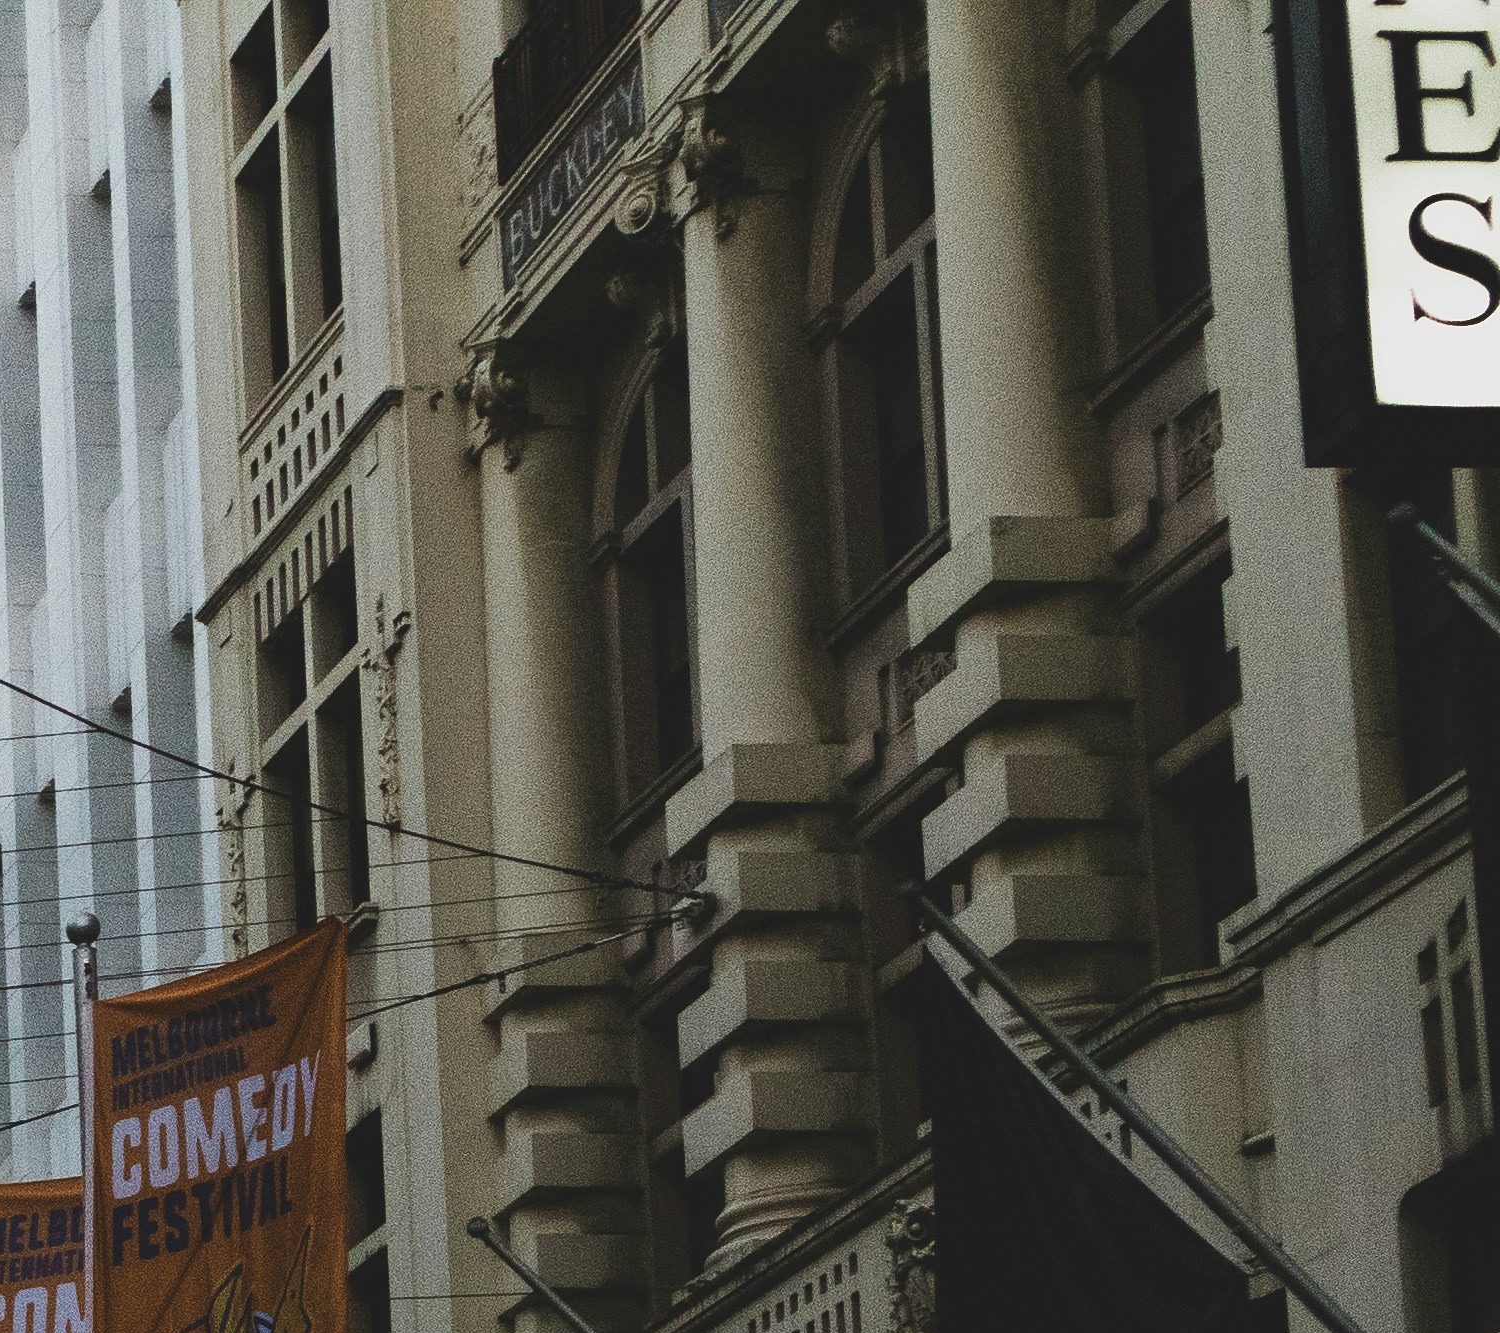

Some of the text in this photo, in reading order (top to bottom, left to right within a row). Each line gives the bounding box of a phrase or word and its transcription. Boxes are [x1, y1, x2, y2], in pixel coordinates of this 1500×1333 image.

[508, 65, 638, 265] BUCKLEY
[111, 984, 276, 1078] MELBOURNE
[112, 1045, 248, 1110] INTERNATIONAL
[110, 1049, 321, 1200] COMEDY
[112, 1156, 292, 1266] FESTIVAL
